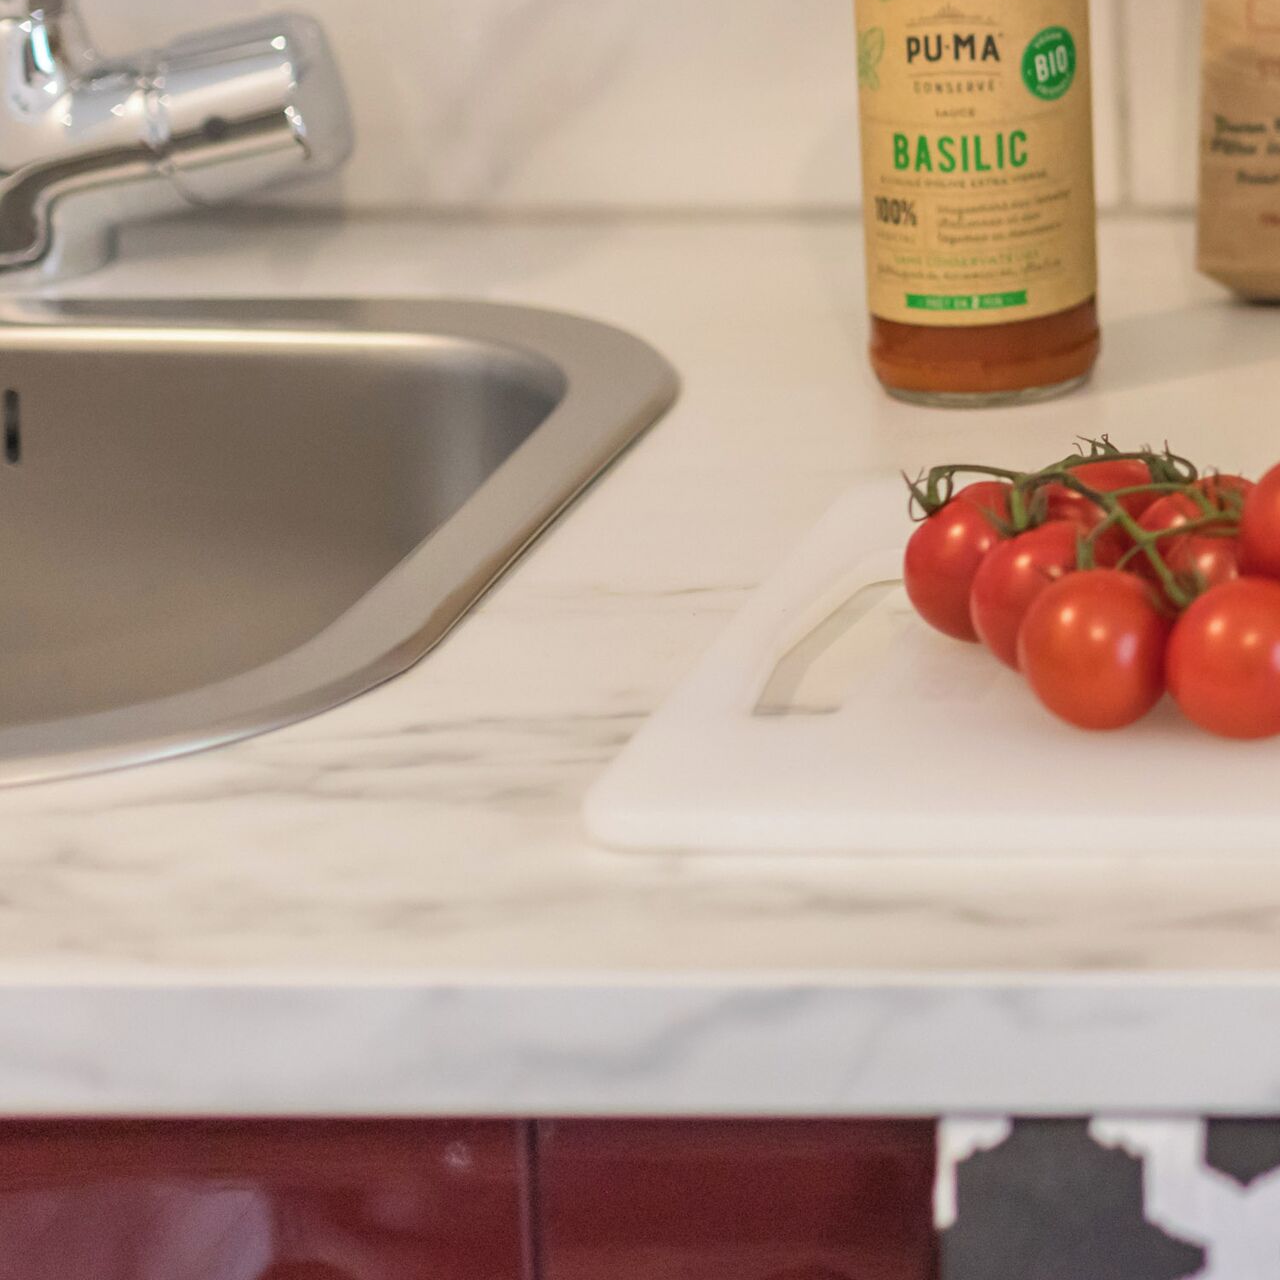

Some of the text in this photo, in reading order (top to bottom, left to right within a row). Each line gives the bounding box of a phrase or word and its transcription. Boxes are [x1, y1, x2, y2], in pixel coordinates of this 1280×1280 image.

[1034, 45, 1069, 83] BIO
[893, 129, 1028, 172] BASILIC
[874, 196, 918, 227] 100%
